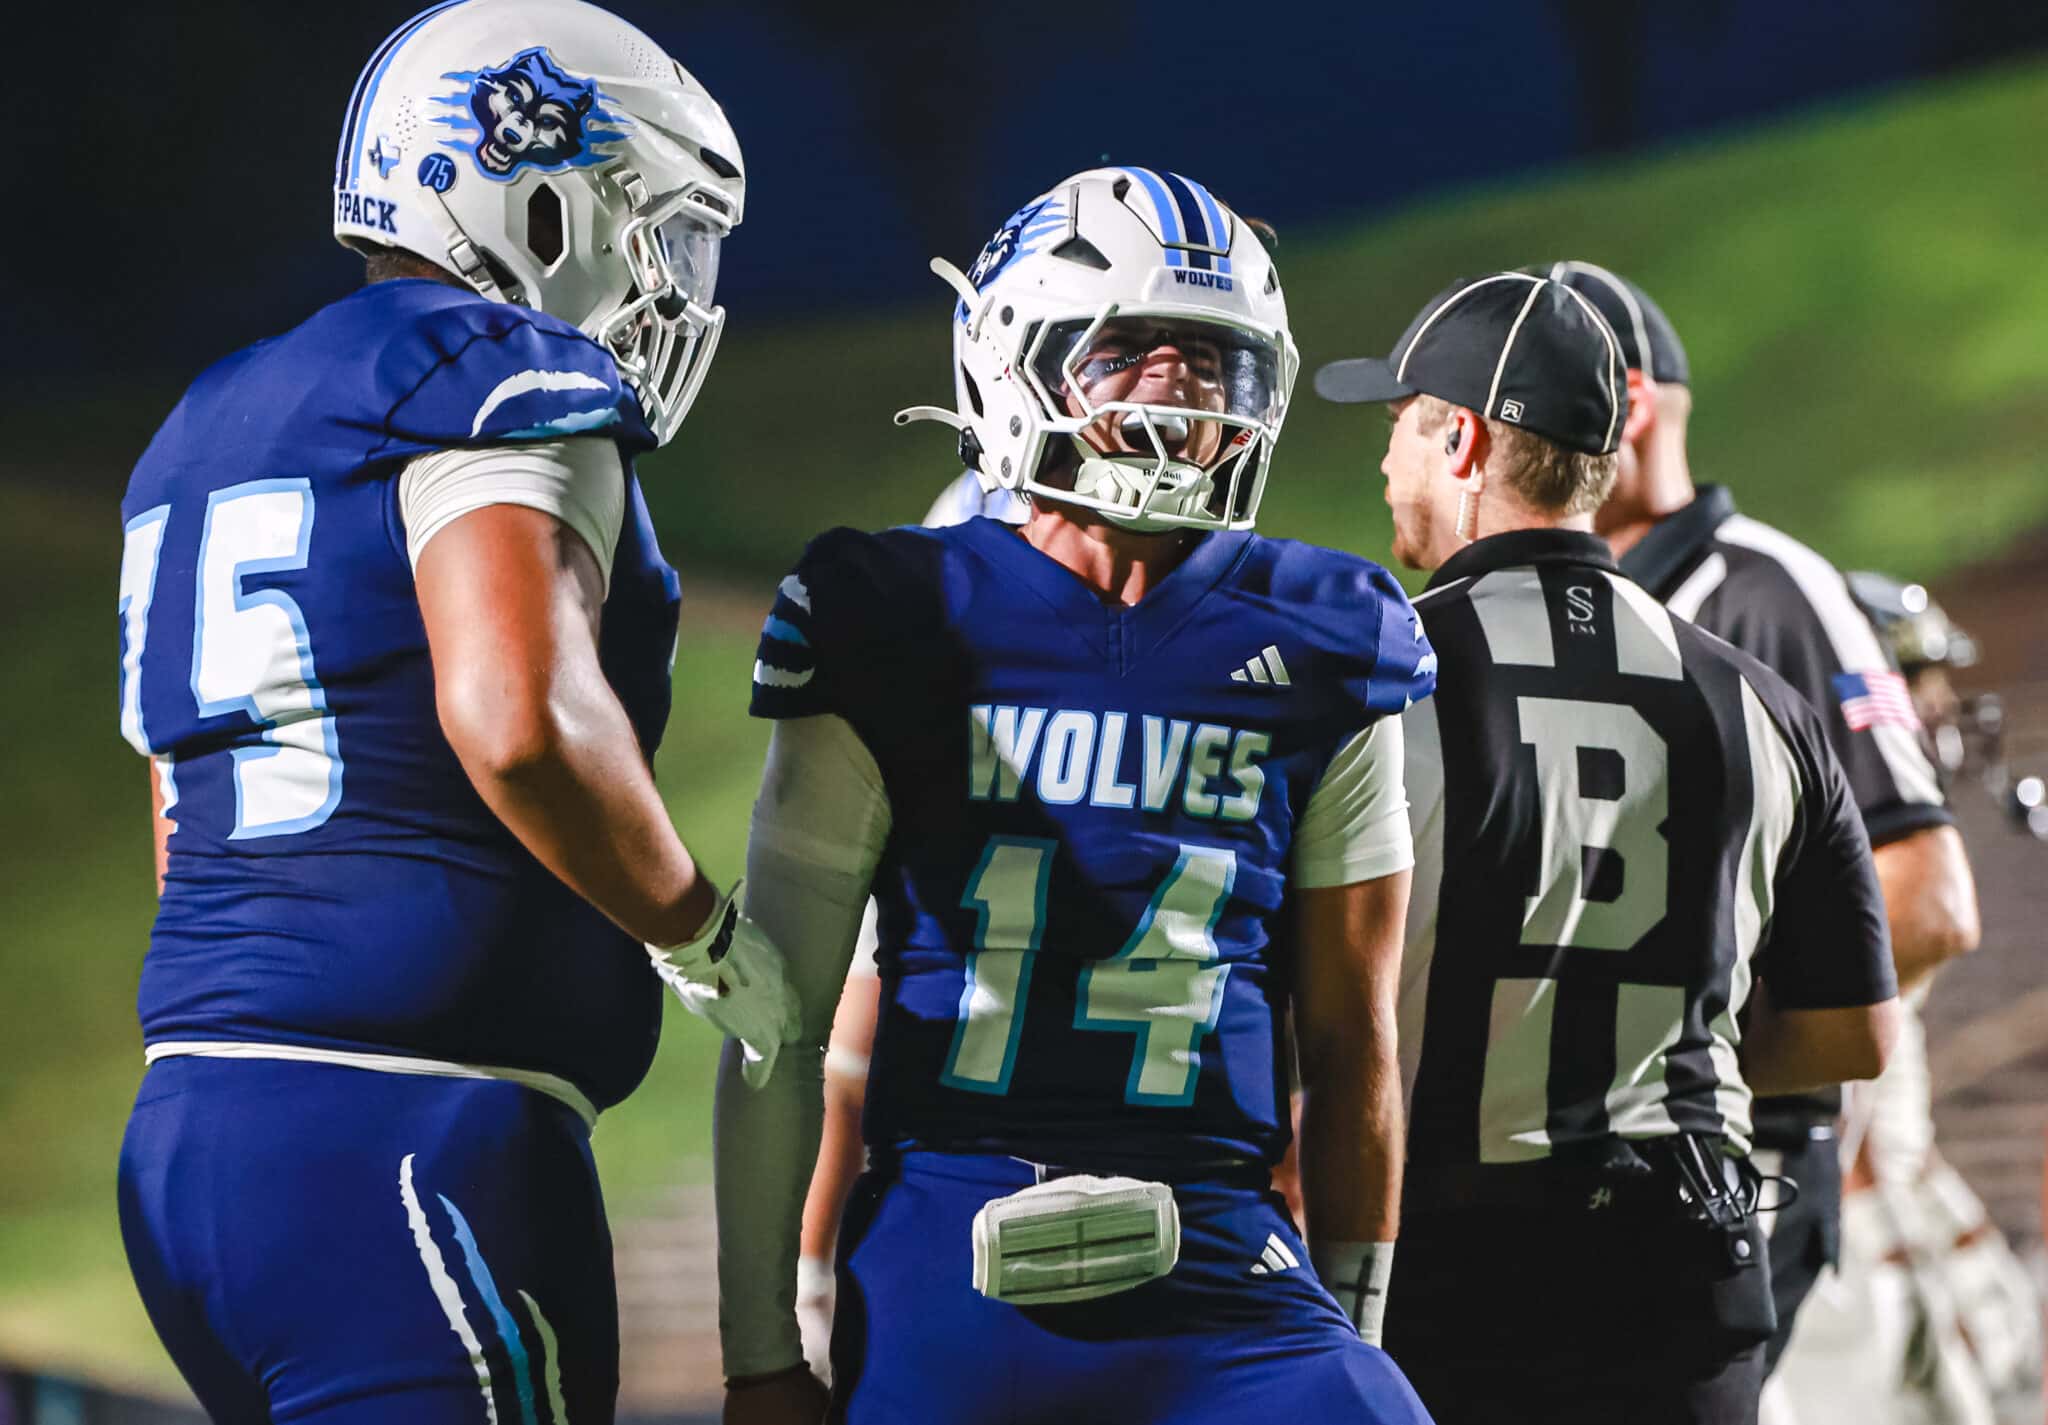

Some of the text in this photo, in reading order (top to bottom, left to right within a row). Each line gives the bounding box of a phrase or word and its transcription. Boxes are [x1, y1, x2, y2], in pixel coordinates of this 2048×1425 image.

[423, 156, 453, 190] 75
[1173, 269, 1233, 292] WOLVES
[118, 476, 345, 841] 75
[968, 704, 1273, 821] WOLVES
[1517, 696, 1669, 951] B
[939, 833, 1237, 1107] 14
